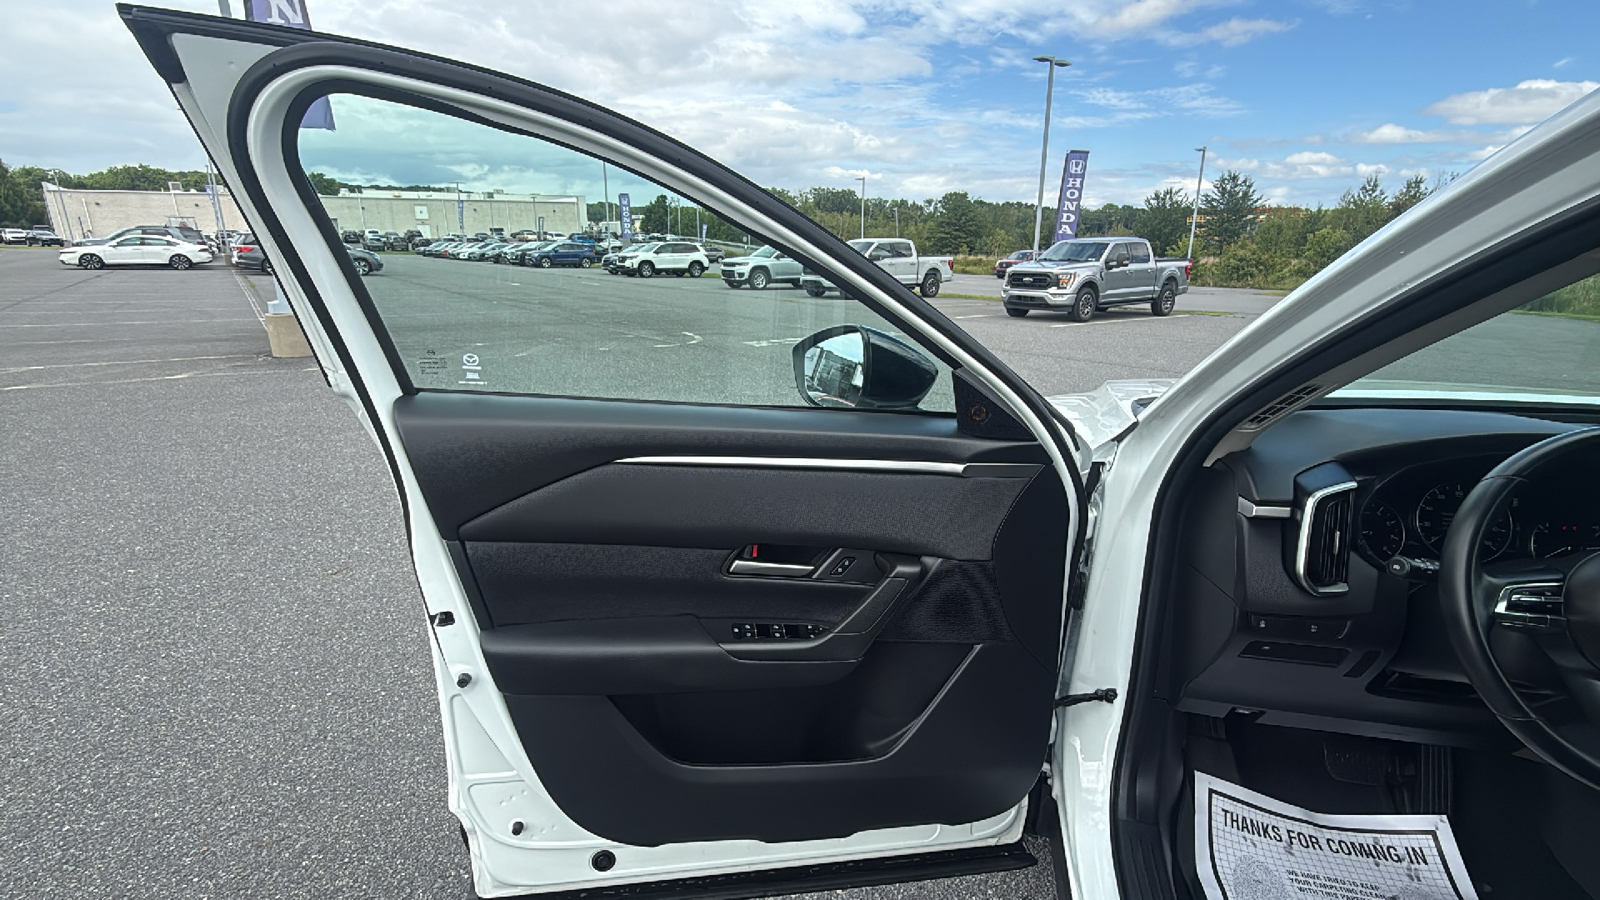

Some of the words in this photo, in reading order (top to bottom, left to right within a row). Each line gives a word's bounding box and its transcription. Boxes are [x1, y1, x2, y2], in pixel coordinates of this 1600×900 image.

[1057, 178, 1082, 235] HONDA
[622, 206, 632, 234] HONDA
[1221, 808, 1283, 842] THANKS
[1286, 829, 1323, 851] FOR
[1326, 838, 1402, 863] COMING
[1404, 846, 1429, 865] IN
[1288, 876, 1312, 887] YOUR
[1313, 881, 1359, 895] CARPETING
[1359, 889, 1387, 900] CLEAN
[1297, 886, 1319, 895] WITH
[1300, 871, 1321, 880] HAVE
[1322, 874, 1346, 885] TRIED
[1360, 882, 1380, 891] KEEP
